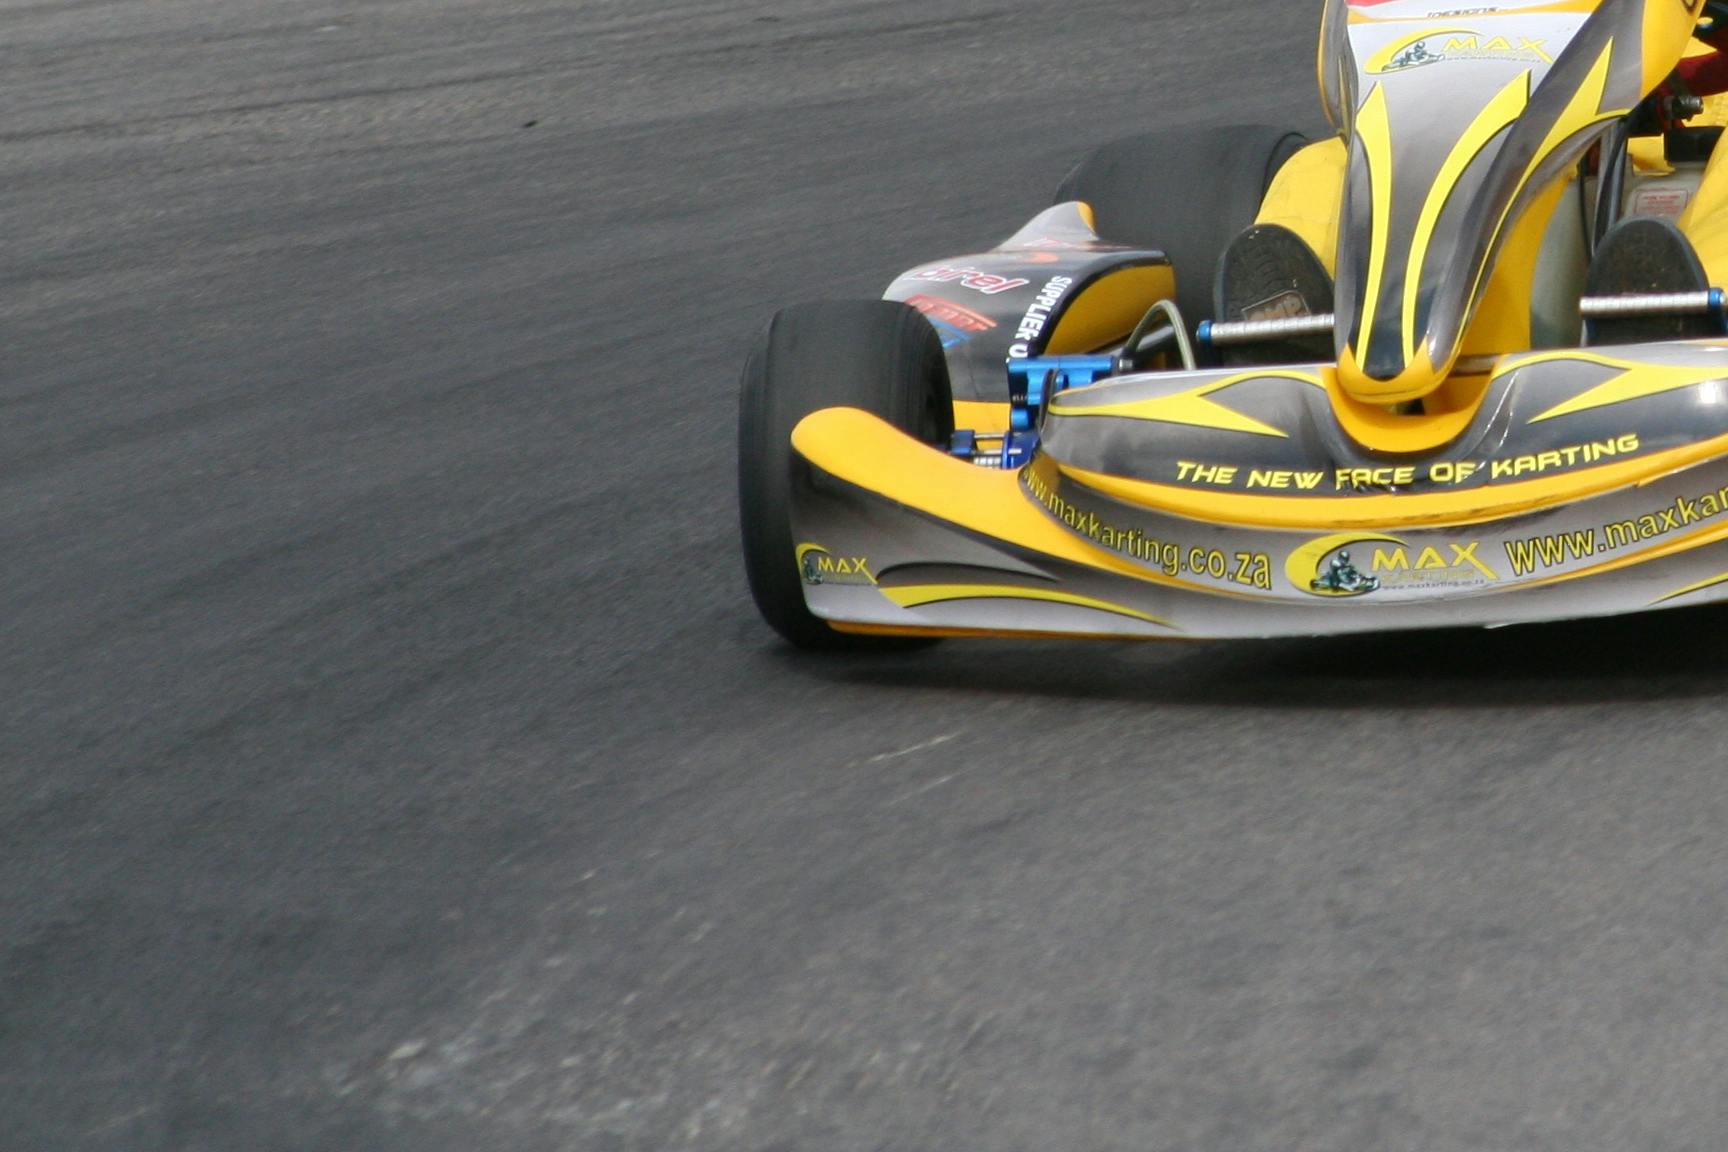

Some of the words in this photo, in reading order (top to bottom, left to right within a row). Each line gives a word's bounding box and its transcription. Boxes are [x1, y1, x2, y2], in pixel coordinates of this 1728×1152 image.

[1440, 35, 1557, 65] MAX
[1014, 274, 1073, 341] SUPPLIER
[1176, 461, 1237, 484] THE
[1246, 469, 1323, 490] NEW
[1335, 466, 1416, 491] FACE
[1430, 462, 1477, 484] OF
[1491, 433, 1640, 480] KARTING
[818, 556, 878, 585] MAX
[1372, 542, 1498, 581] MAX
